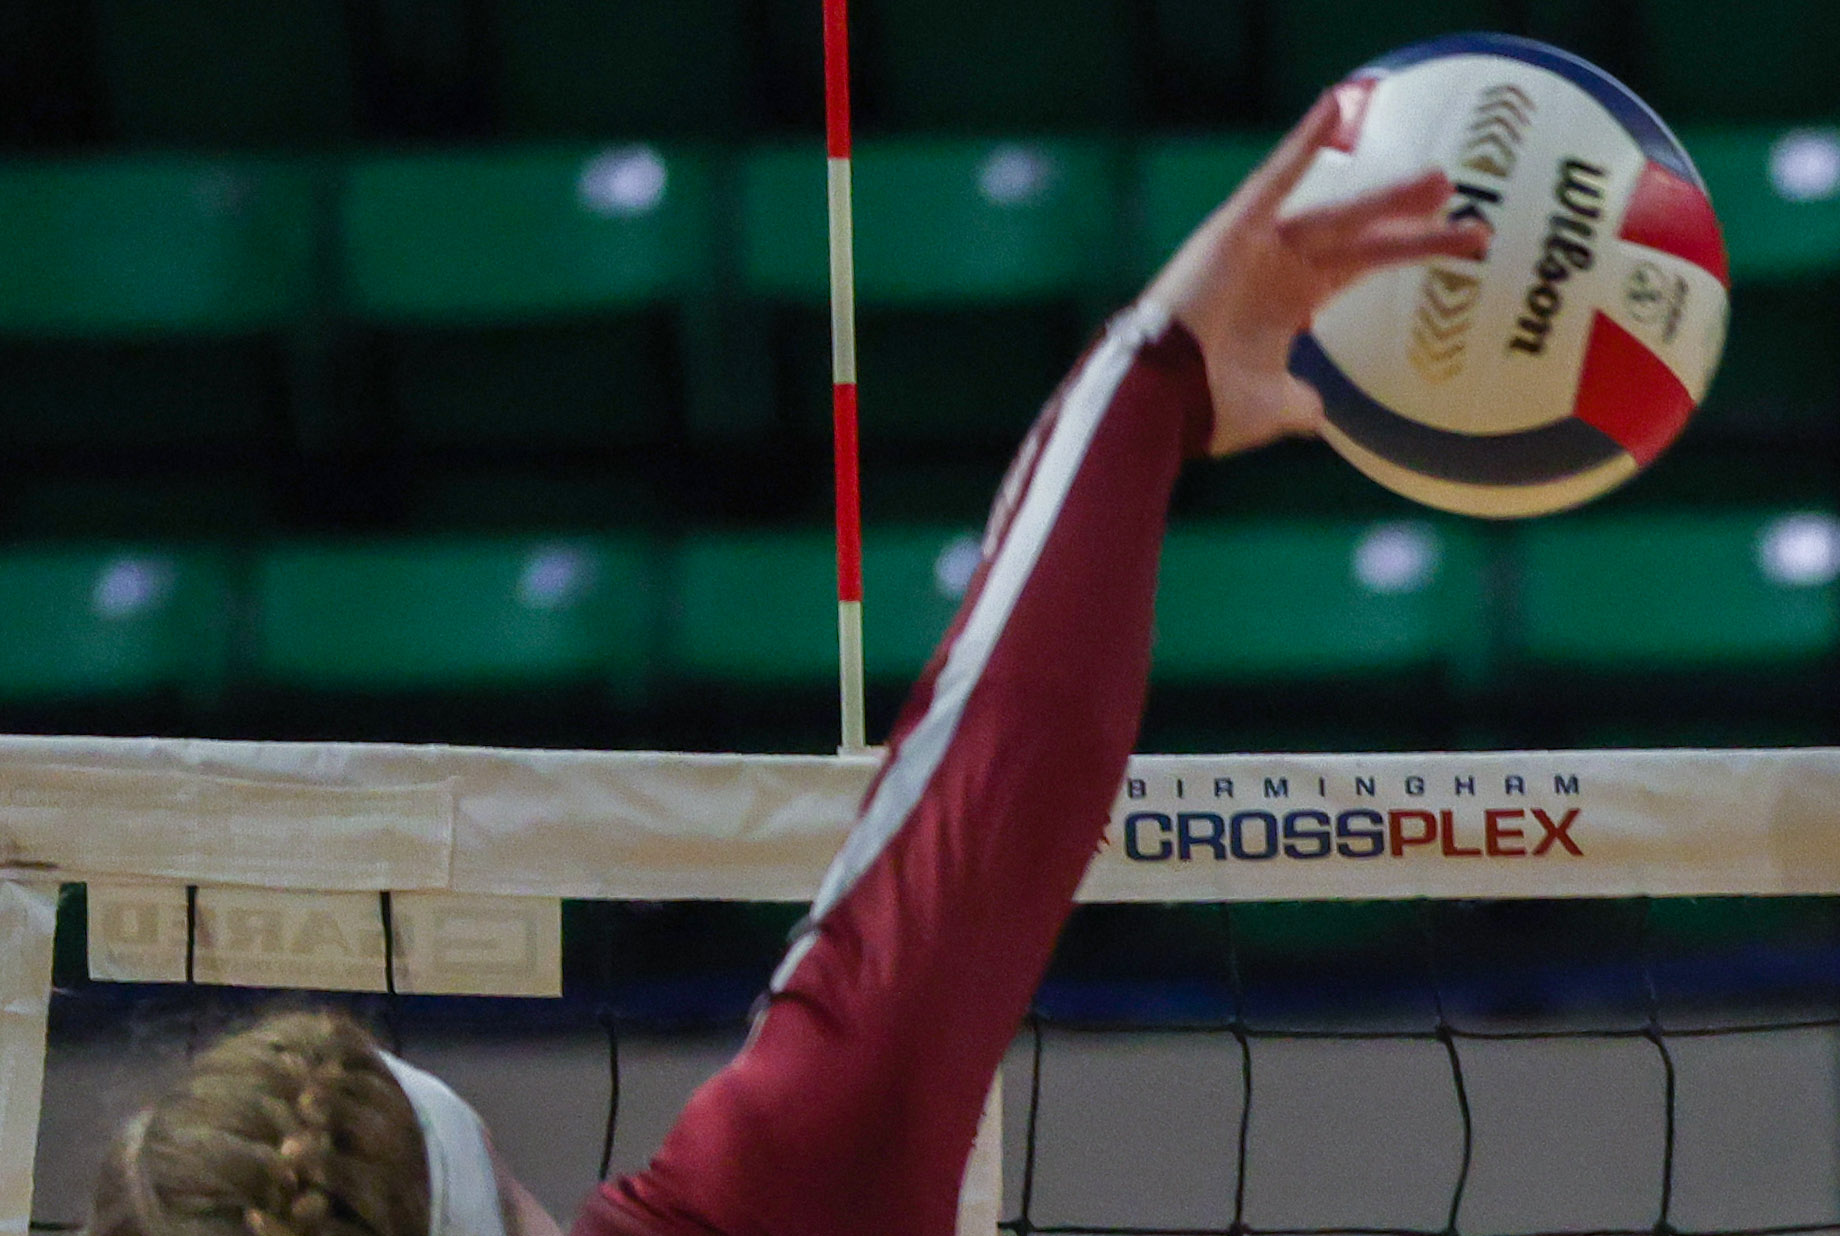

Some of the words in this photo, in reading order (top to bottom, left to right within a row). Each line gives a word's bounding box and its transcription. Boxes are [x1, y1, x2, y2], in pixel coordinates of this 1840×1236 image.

[1510, 157, 1608, 354] Wilson
[1127, 775, 1580, 798] BIRMINGHAM
[1123, 808, 1585, 862] CROSSPLEX
